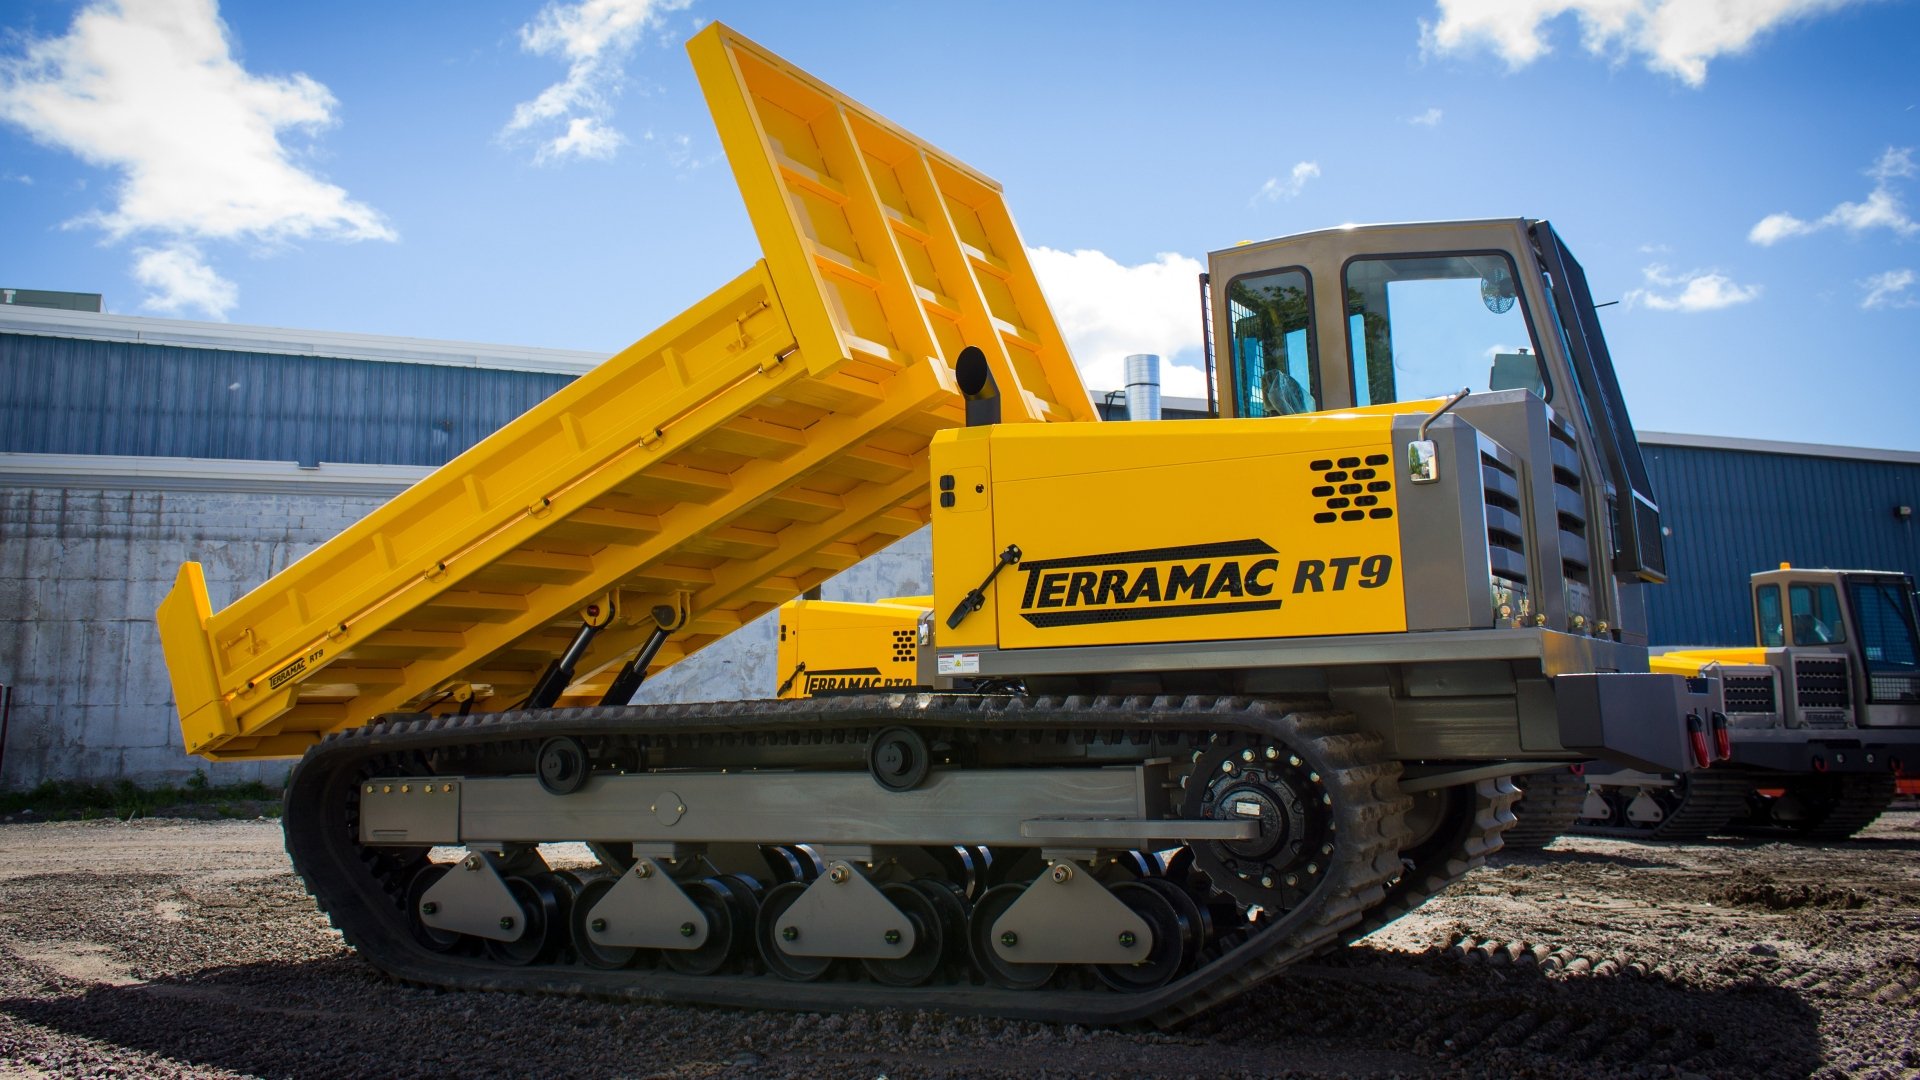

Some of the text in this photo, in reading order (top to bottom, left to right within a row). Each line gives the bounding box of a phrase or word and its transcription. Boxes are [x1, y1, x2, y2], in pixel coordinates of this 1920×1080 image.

[1018, 555, 1393, 609] TERRAMAC RT9
[268, 649, 324, 688] TERRAMAC RT9
